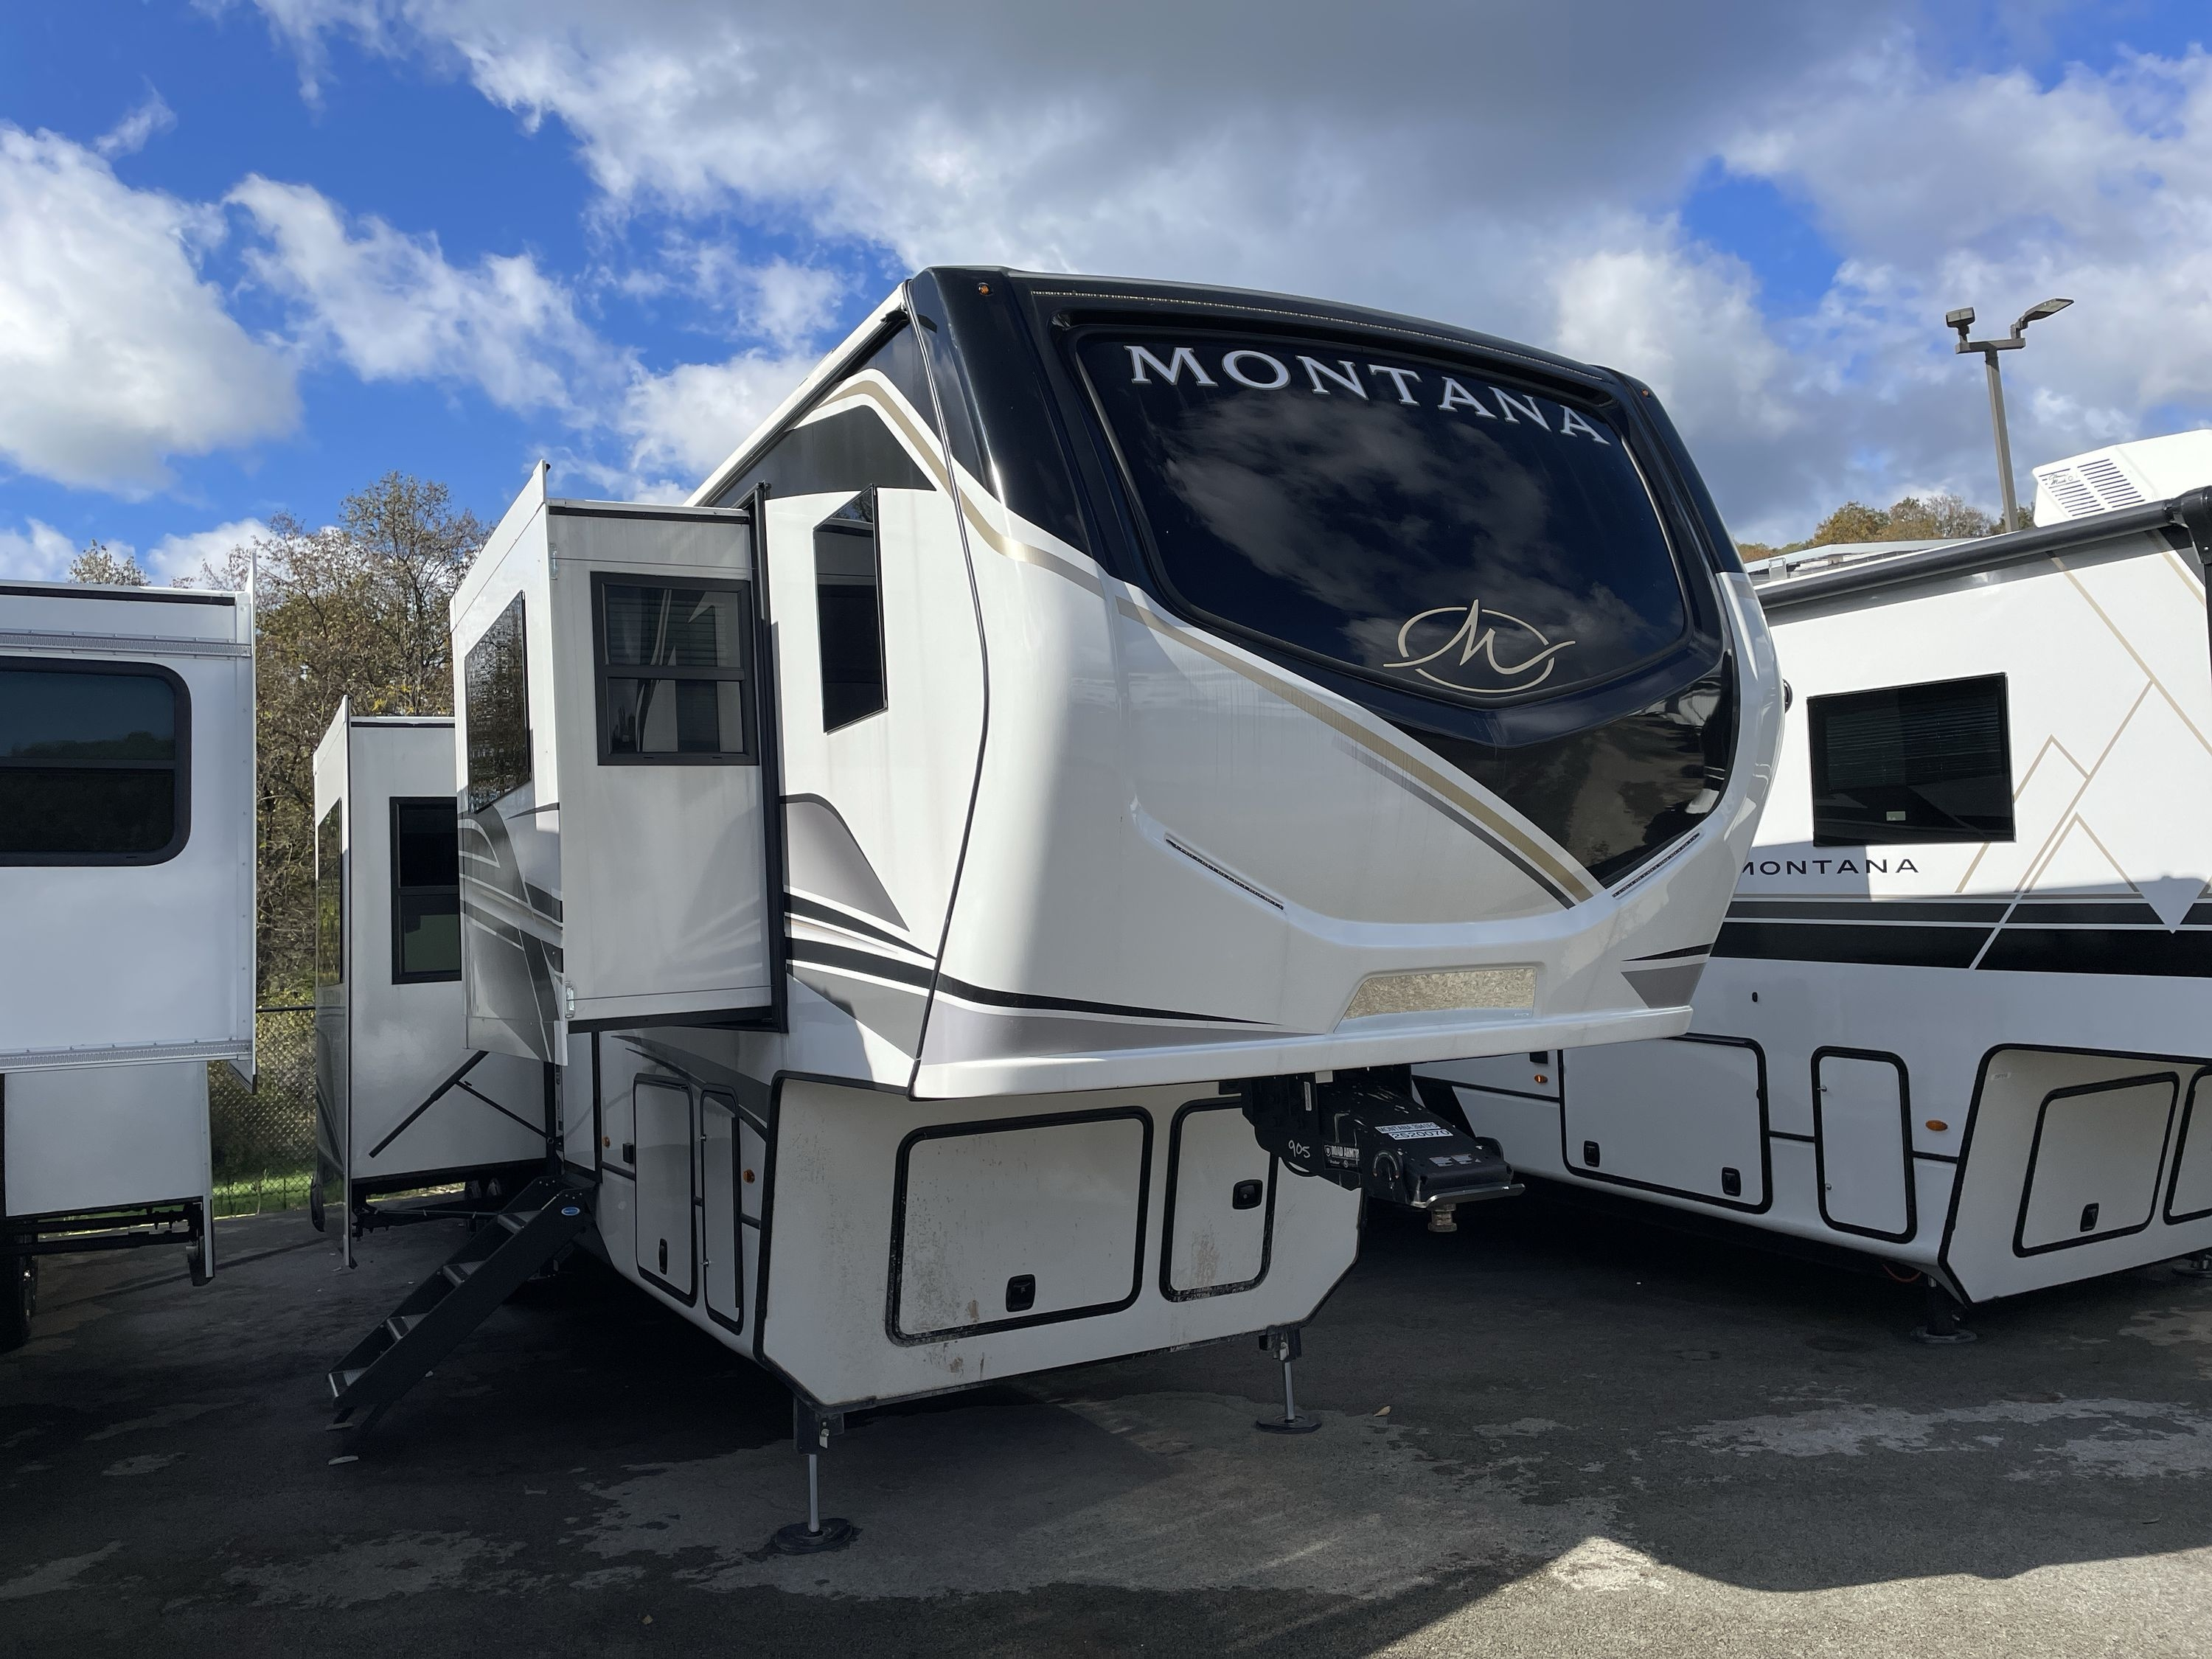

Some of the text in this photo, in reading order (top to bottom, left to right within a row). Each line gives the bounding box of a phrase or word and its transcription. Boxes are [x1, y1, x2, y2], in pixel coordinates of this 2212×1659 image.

[1124, 345, 1610, 445] MONTANA
[1391, 1130, 1450, 1138] 2520070
[1288, 1139, 1310, 1158] 905
